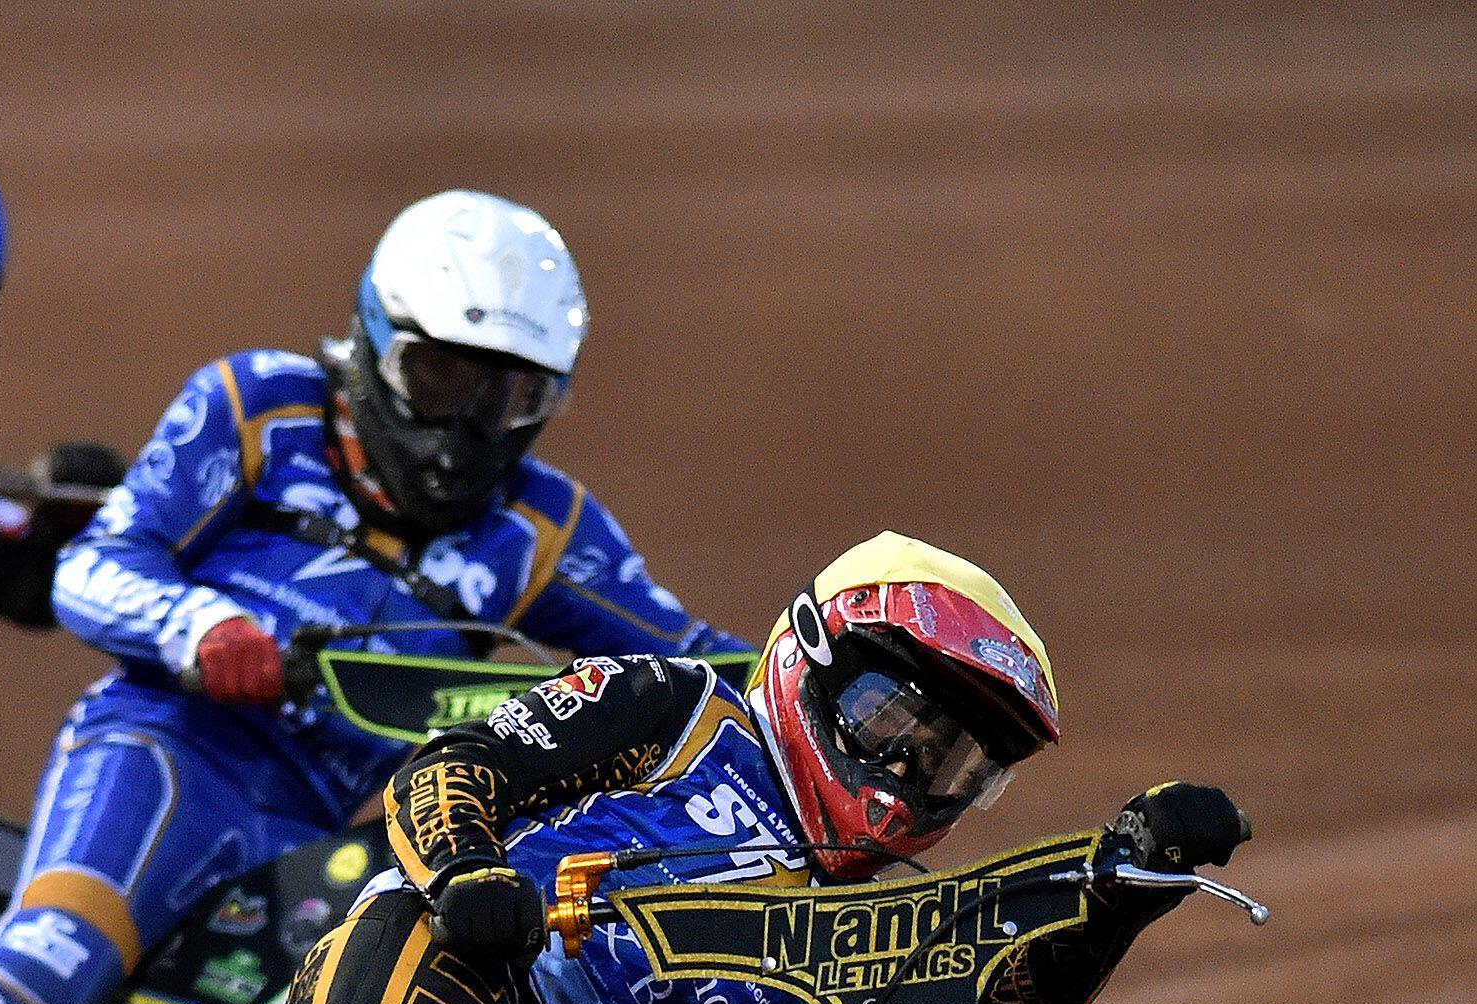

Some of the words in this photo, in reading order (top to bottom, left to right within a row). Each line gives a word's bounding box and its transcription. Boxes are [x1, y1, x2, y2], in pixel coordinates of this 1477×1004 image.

[723, 763, 769, 812] KING'S
[762, 899, 815, 972] N
[830, 881, 959, 961] and
[976, 878, 1015, 945] L
[816, 944, 976, 998] LETTINGS
